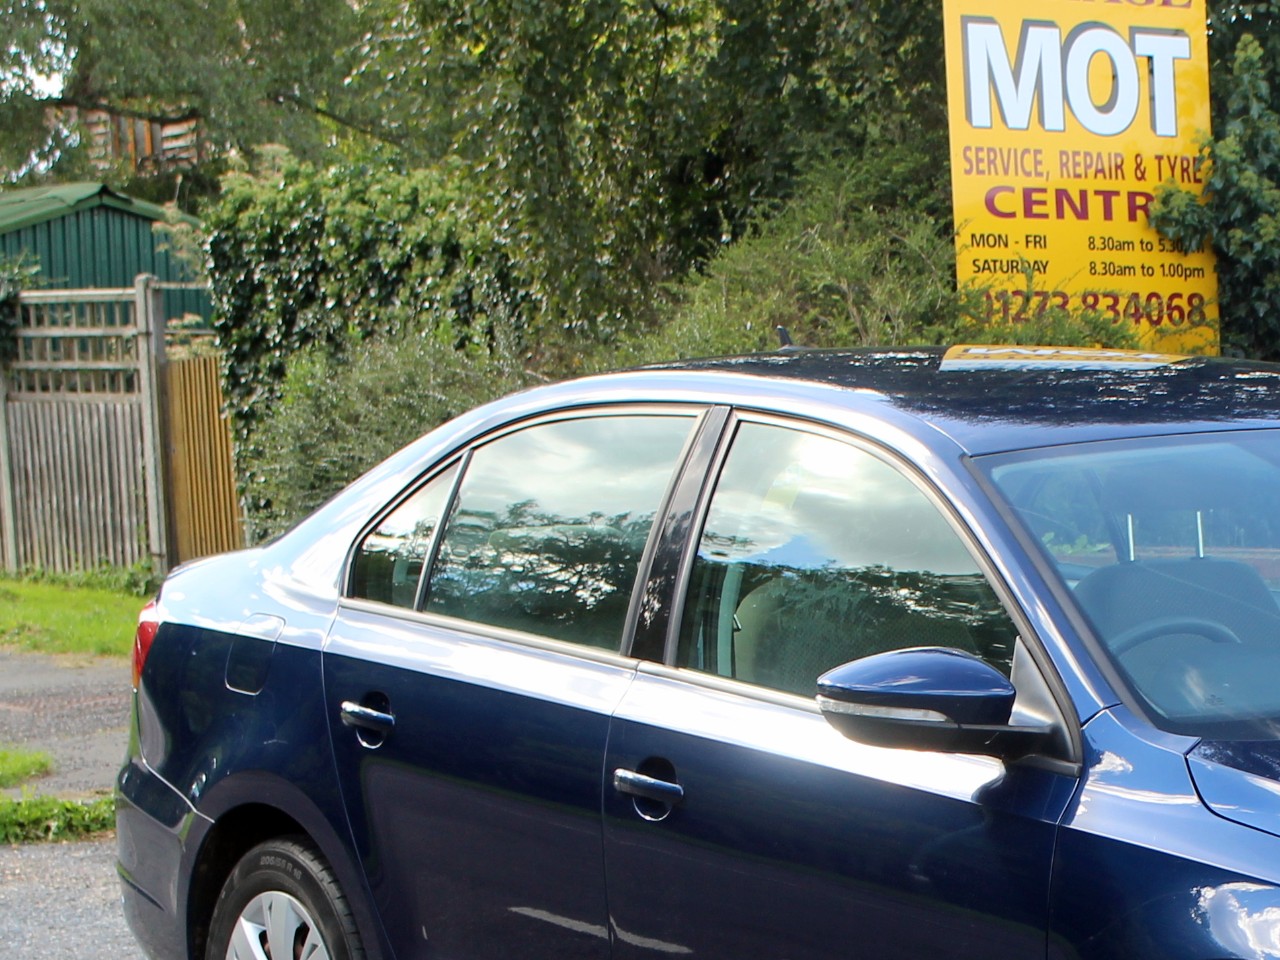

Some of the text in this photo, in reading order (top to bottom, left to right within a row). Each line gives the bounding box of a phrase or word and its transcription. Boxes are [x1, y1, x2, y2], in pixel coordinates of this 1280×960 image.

[961, 15, 1191, 137] MOT
[963, 146, 1203, 184] SERVICE, REPAIR & TYRE
[984, 186, 1155, 223] CENTR
[970, 233, 1009, 249] MON
[1025, 234, 1048, 250] FRI
[1088, 236, 1135, 252] 8.30am
[1139, 238, 1154, 252] to
[972, 258, 1205, 283] SATURDAY 8.30am to 1.00pm
[1081, 291, 1207, 328] 834068
